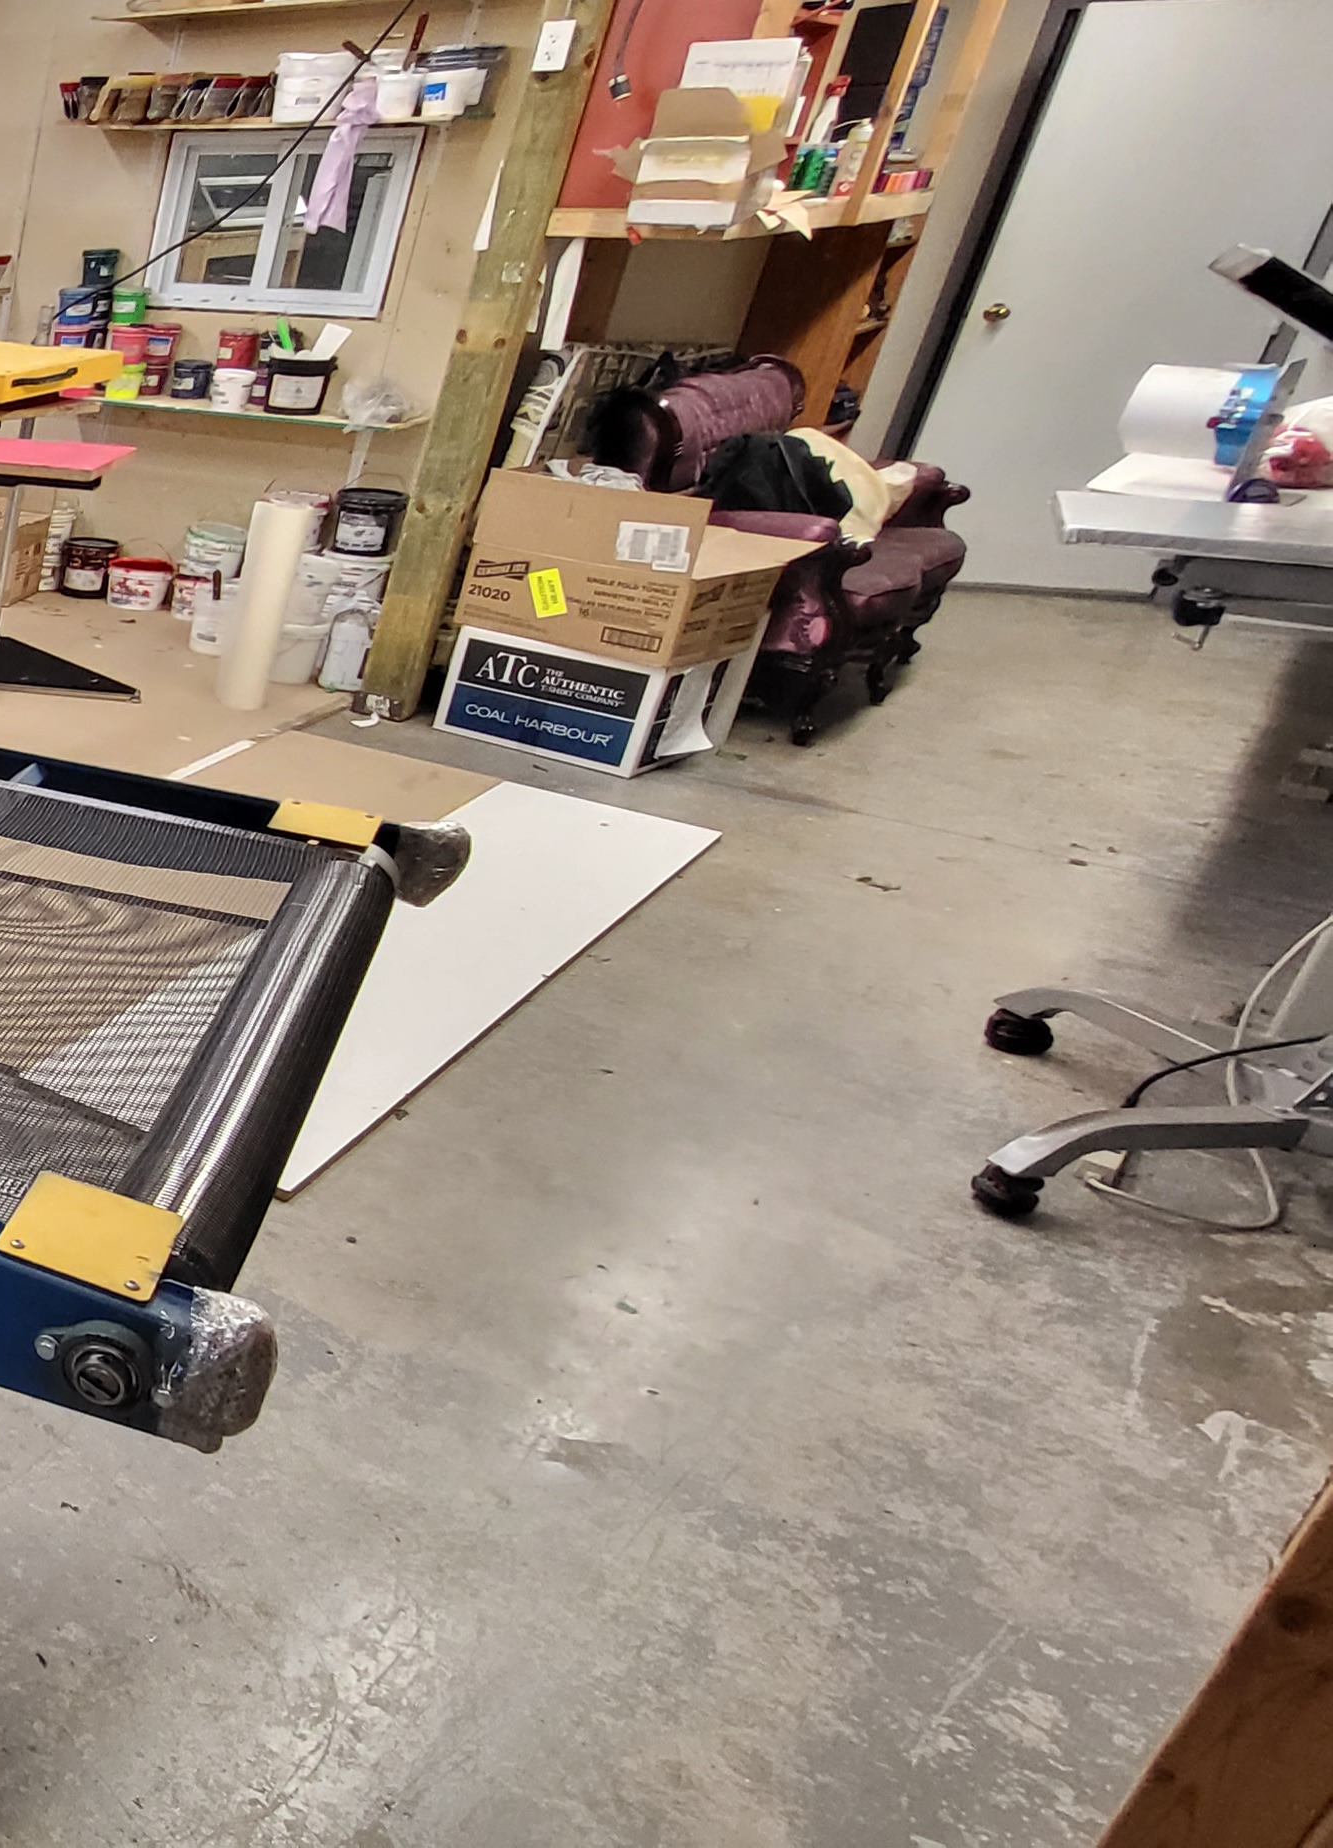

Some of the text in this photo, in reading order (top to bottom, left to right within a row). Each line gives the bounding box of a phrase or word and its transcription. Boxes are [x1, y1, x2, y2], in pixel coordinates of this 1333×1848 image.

[468, 583, 511, 602] 21020
[475, 651, 540, 689] ATC
[545, 668, 564, 678] THE
[540, 675, 626, 701] AUTHENTIC
[465, 703, 610, 747] COAL HARBOUR
